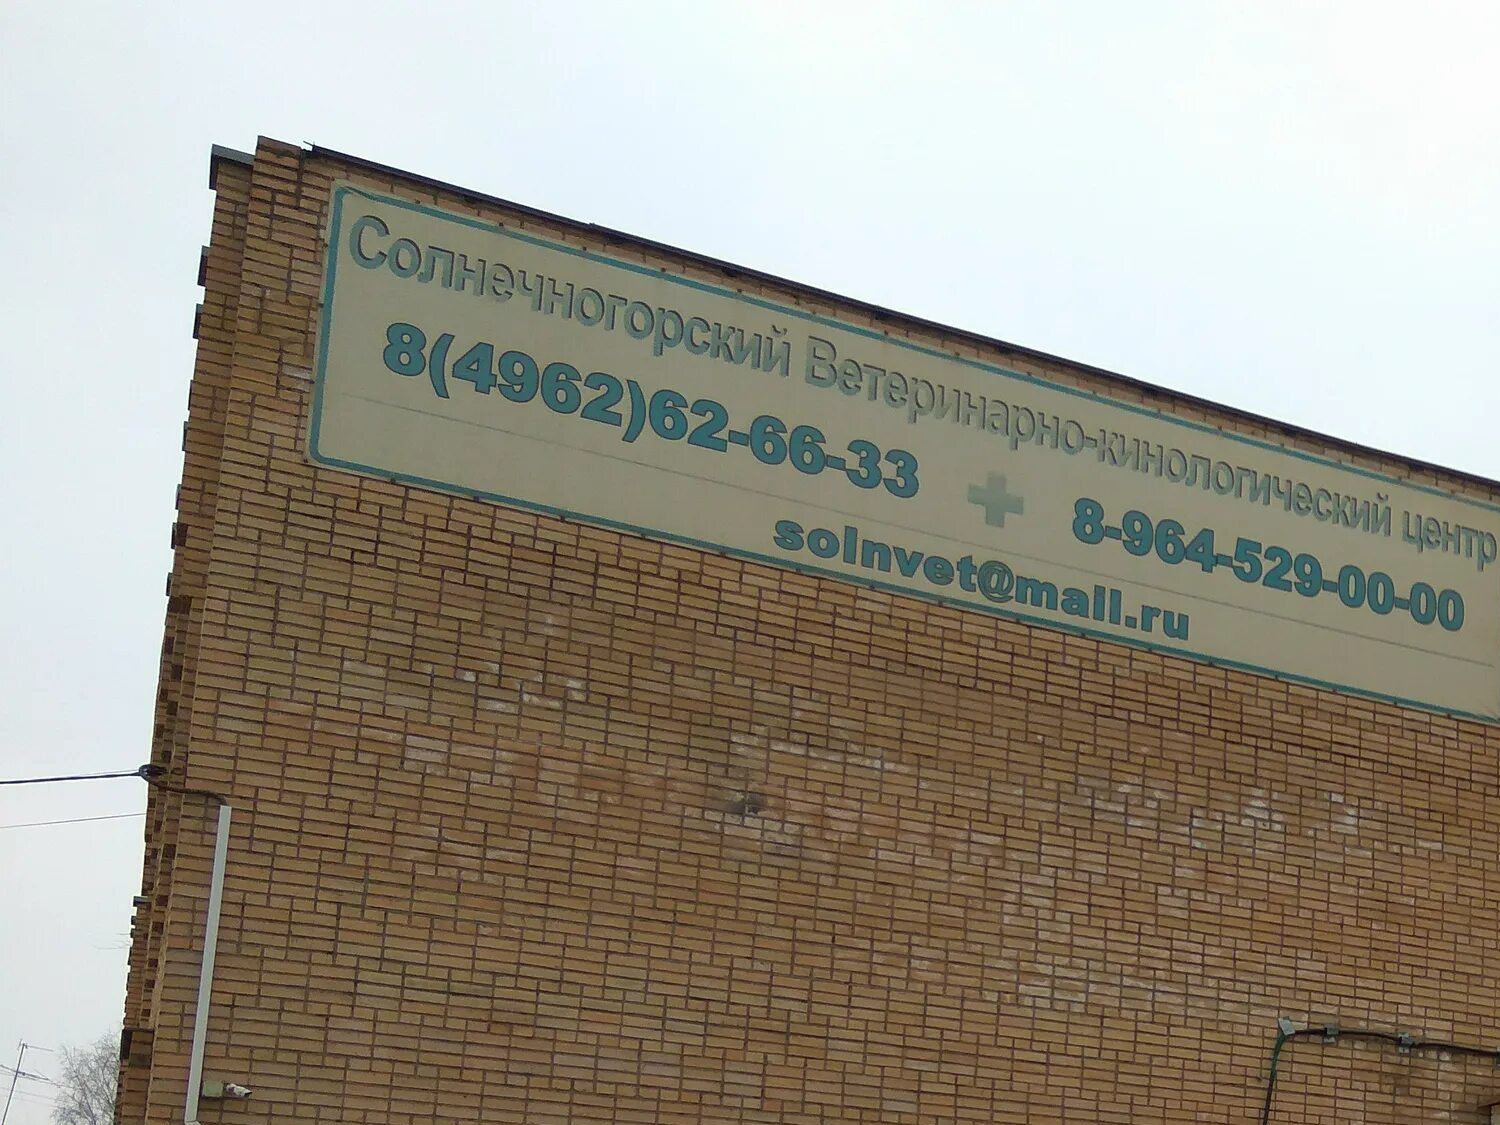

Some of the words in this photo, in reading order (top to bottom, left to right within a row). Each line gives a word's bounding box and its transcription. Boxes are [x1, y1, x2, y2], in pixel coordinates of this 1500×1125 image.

[348, 214, 792, 377] Солнечногорский
[804, 335, 1394, 540] Ветеринарно-кинологический
[1401, 510, 1498, 573] центр
[383, 322, 920, 499] 8(4962)62-66-33
[773, 519, 1190, 641] solnvet@mail.ru
[1072, 497, 1465, 632] 8-964-529-00-00
